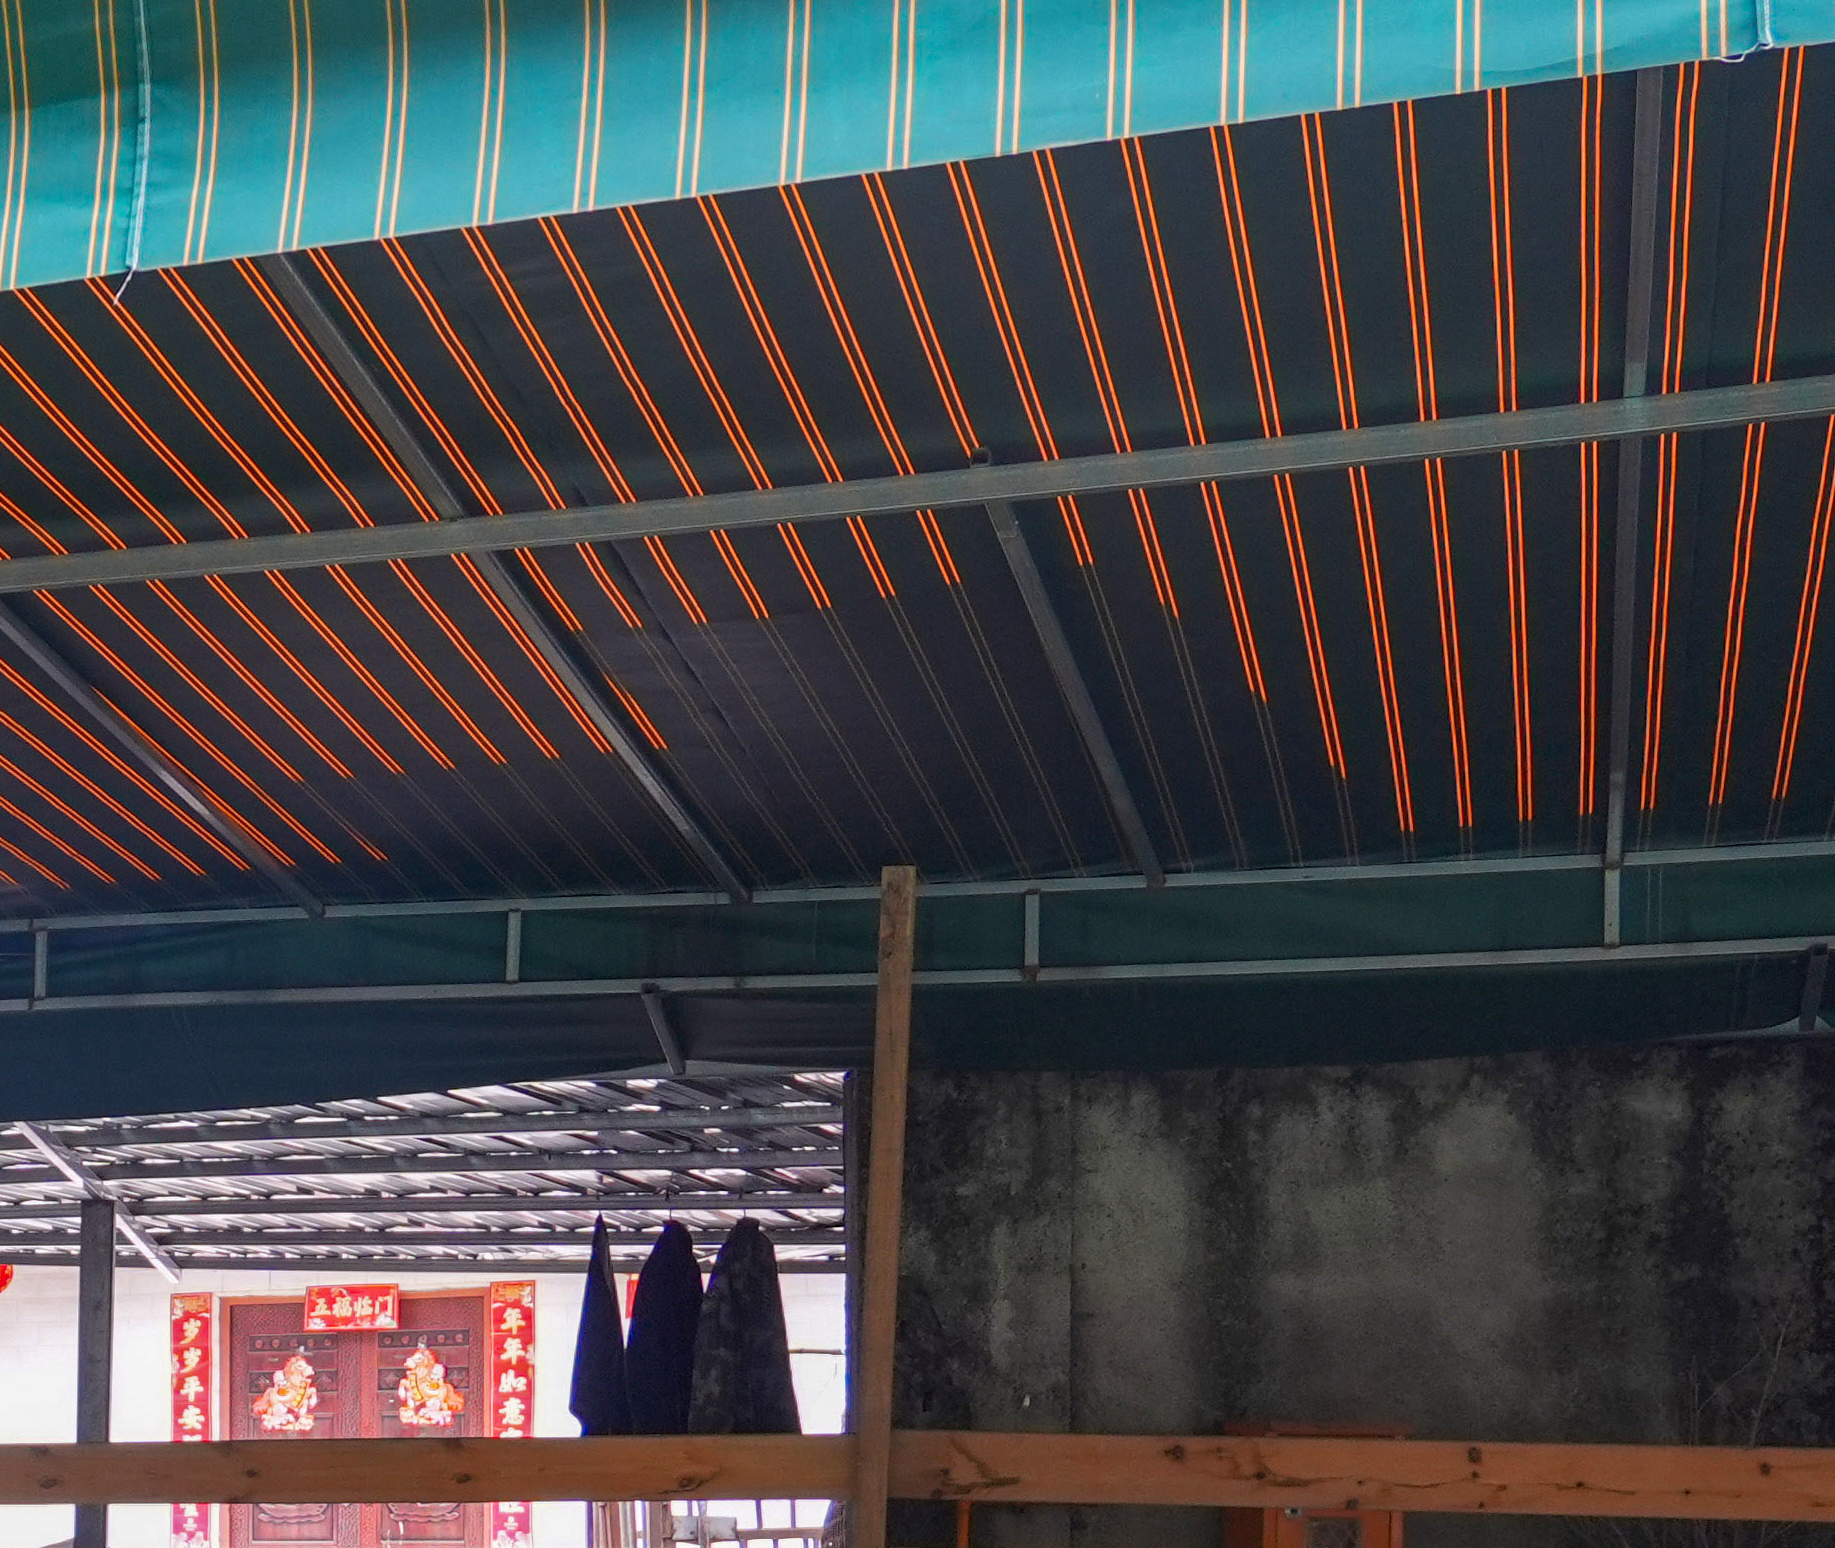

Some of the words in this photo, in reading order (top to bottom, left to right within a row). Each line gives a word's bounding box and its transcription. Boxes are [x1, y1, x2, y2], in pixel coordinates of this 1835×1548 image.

[310, 1295, 393, 1318] 五福临门
[178, 1318, 205, 1441] 岁岁平安
[498, 1307, 527, 1438] 年年如意
